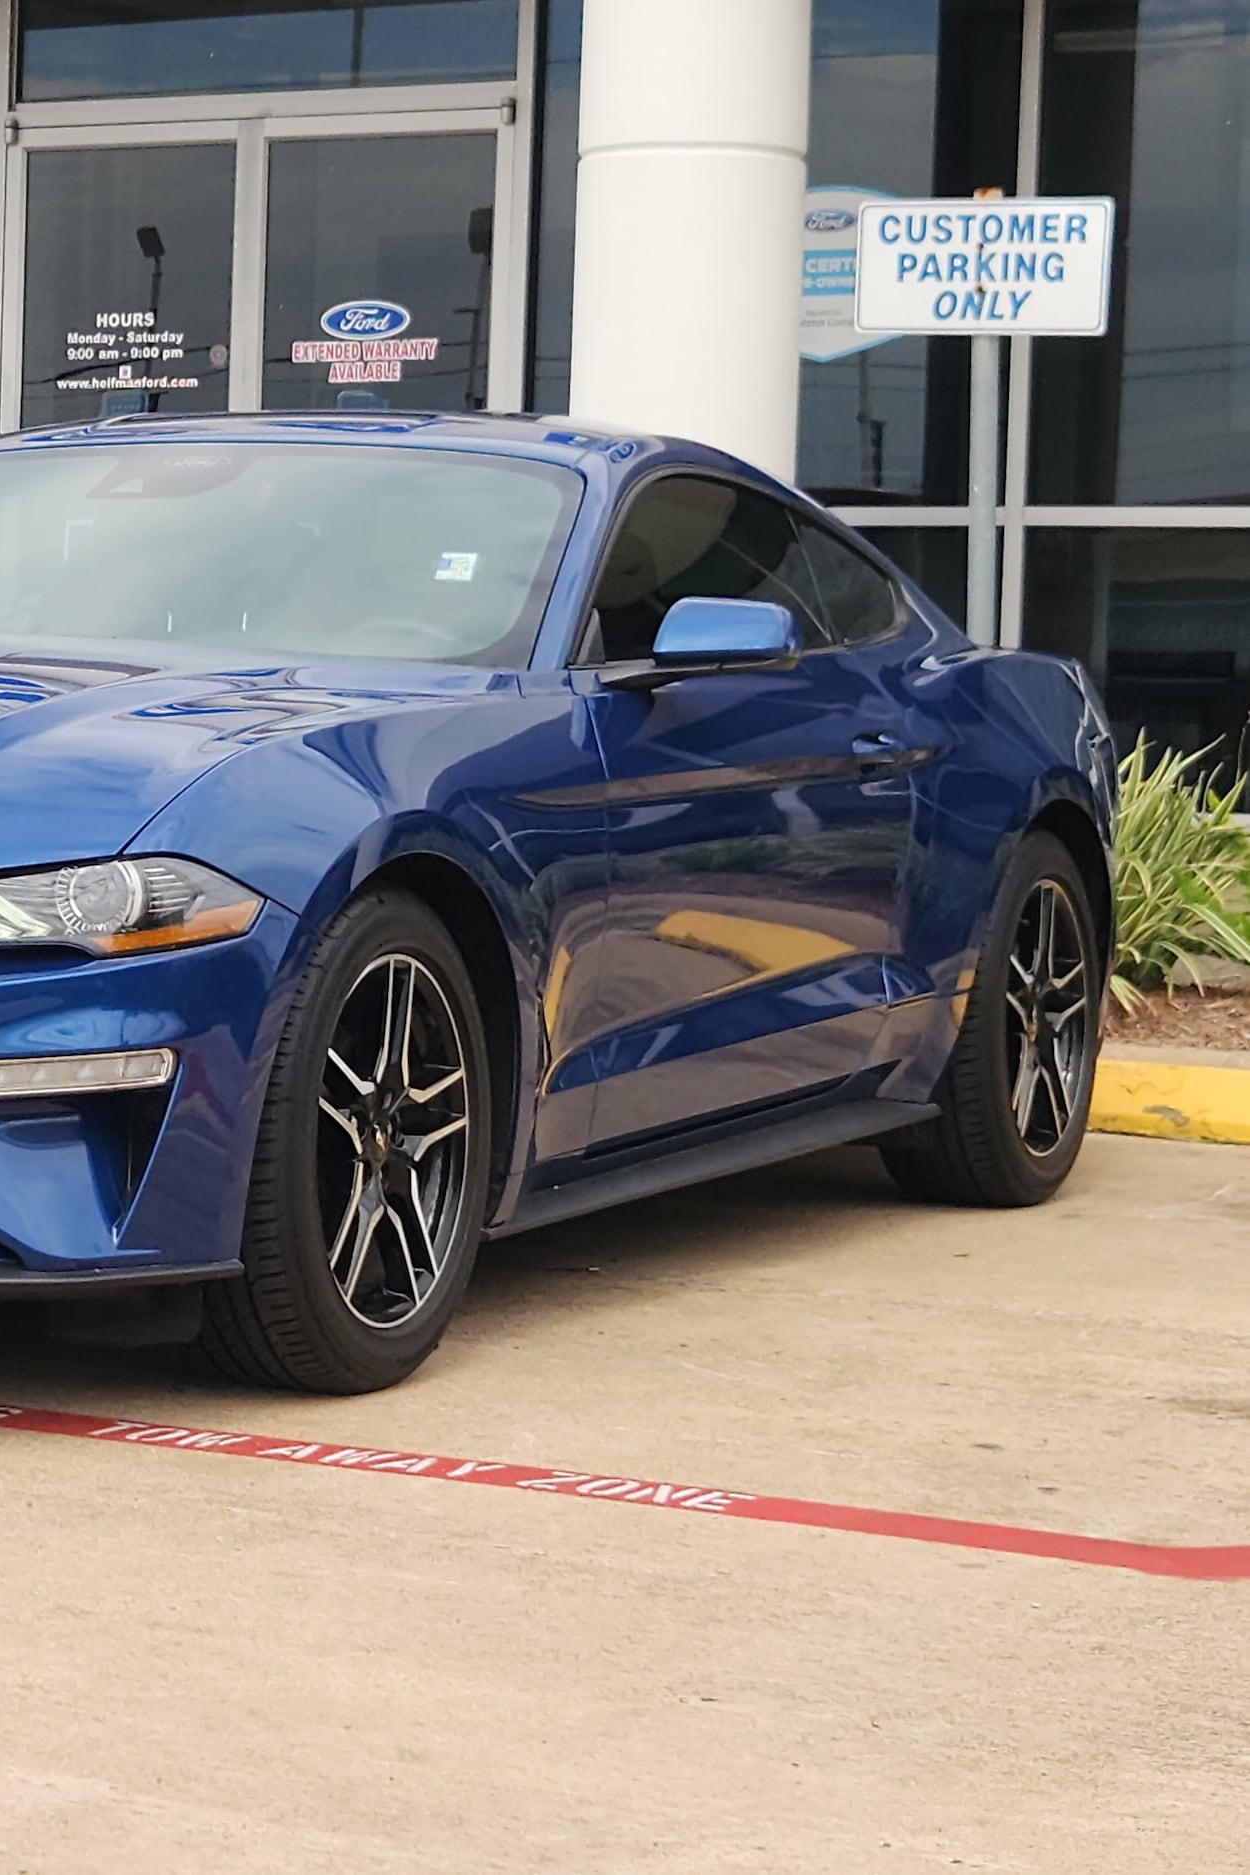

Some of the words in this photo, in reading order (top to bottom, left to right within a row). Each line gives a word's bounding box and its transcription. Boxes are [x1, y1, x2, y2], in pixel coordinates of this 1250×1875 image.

[879, 214, 1088, 243] CUSTOMER
[898, 253, 1066, 283] PARKING
[933, 291, 1032, 320] ONLY
[96, 312, 155, 328] HOURS
[339, 308, 391, 331] Ford
[67, 332, 116, 346] Monday
[126, 331, 184, 345] Saturday
[67, 347, 94, 360] 9:00
[98, 350, 119, 360] am
[162, 349, 183, 361] pm
[293, 341, 360, 361] EXTENDED
[362, 339, 437, 360] WARRANTY
[330, 363, 400, 380] AVAILABLE
[86, 1420, 253, 1449] TOW
[256, 1442, 507, 1479] AWAY
[516, 1470, 757, 1513] ZONE
